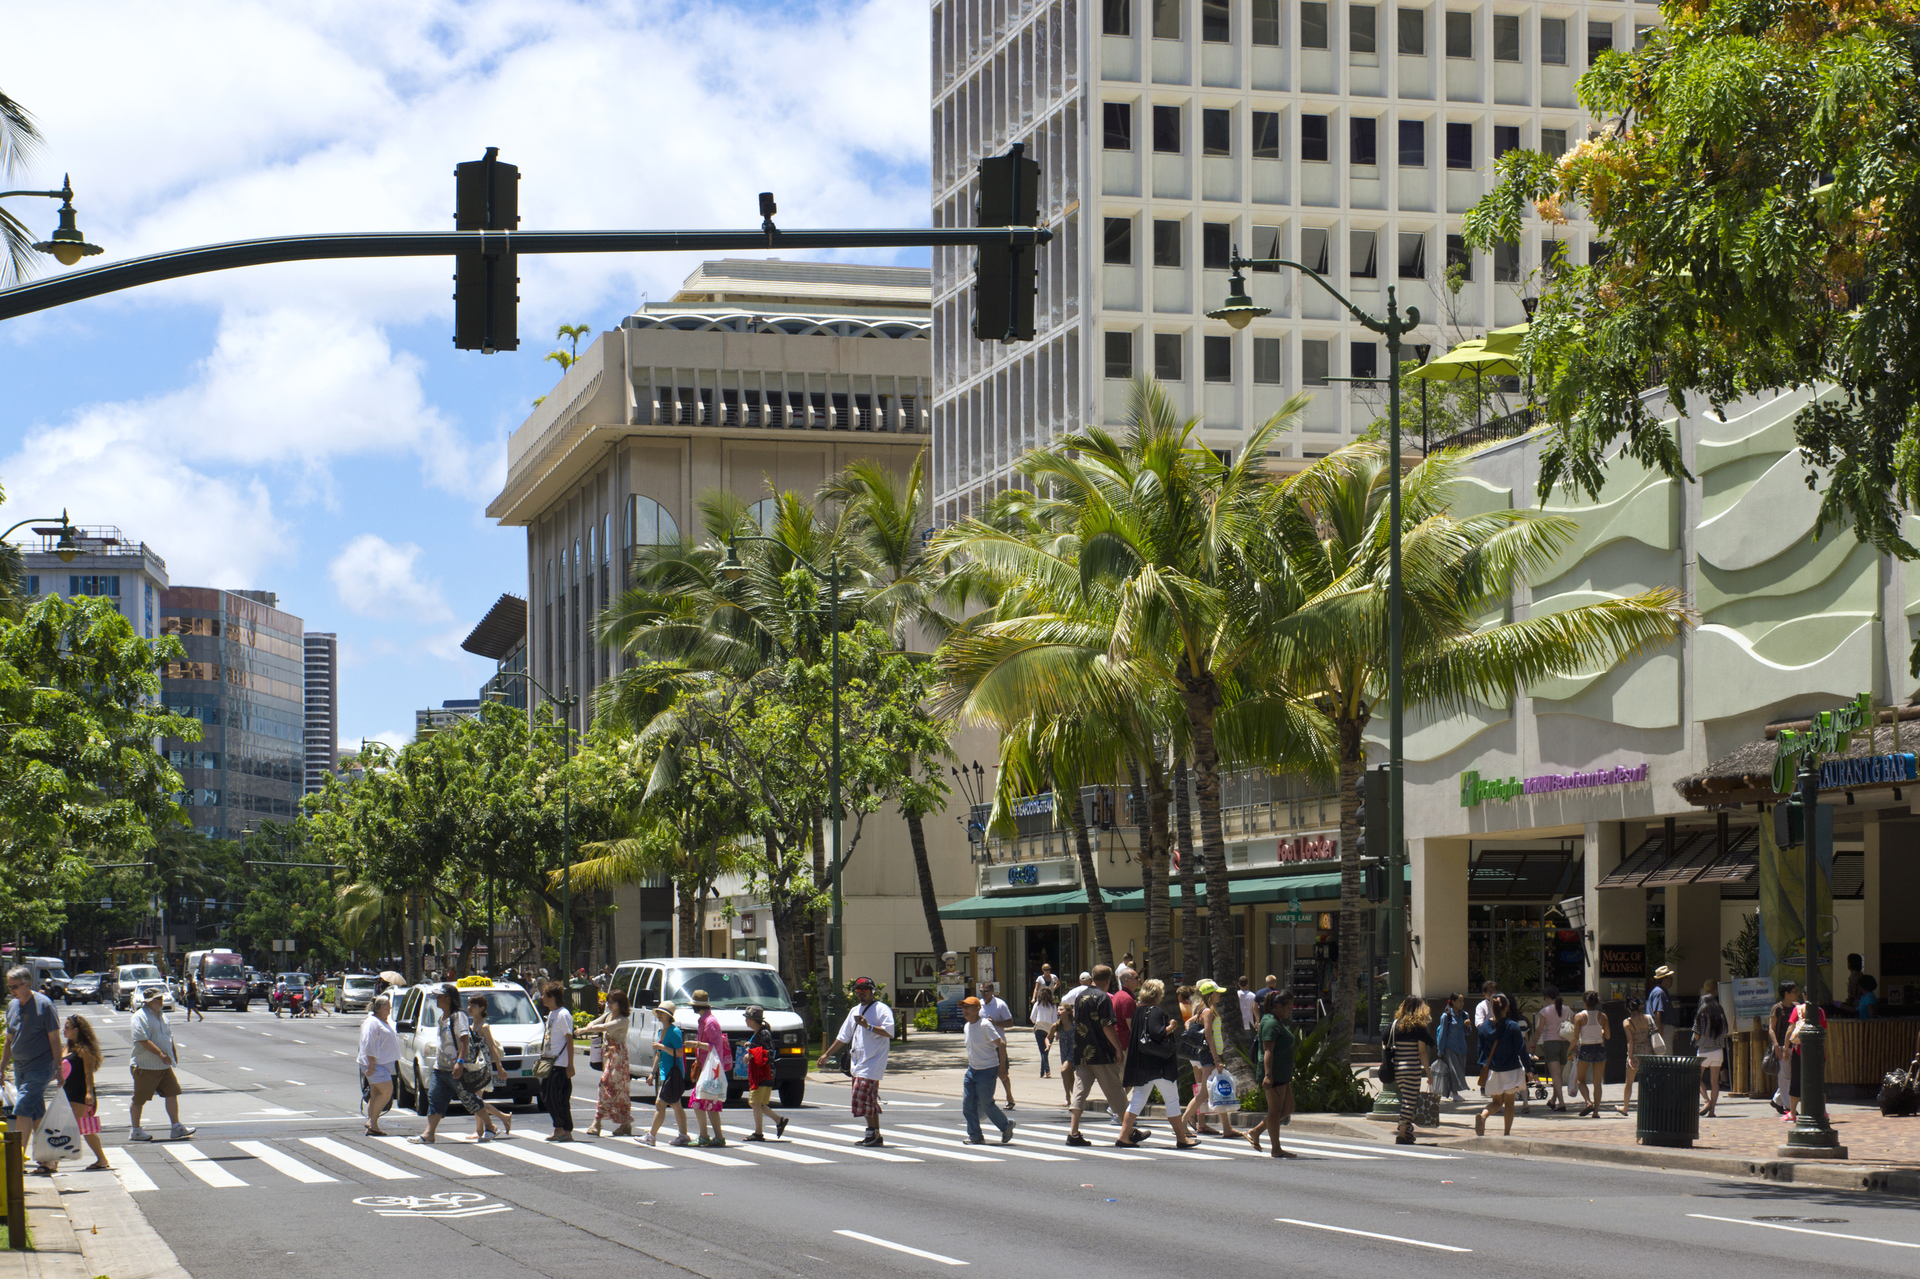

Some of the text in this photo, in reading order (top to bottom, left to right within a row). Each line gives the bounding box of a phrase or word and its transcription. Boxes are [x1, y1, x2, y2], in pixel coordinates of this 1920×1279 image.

[1613, 763, 1648, 785] Resort
[1798, 757, 1871, 791] TAURANT
[1882, 753, 1908, 782] BAR
[1277, 835, 1337, 862] Foot Locker
[1602, 949, 1643, 961] MAGIC OF
[1601, 960, 1644, 973] POLYNESIA
